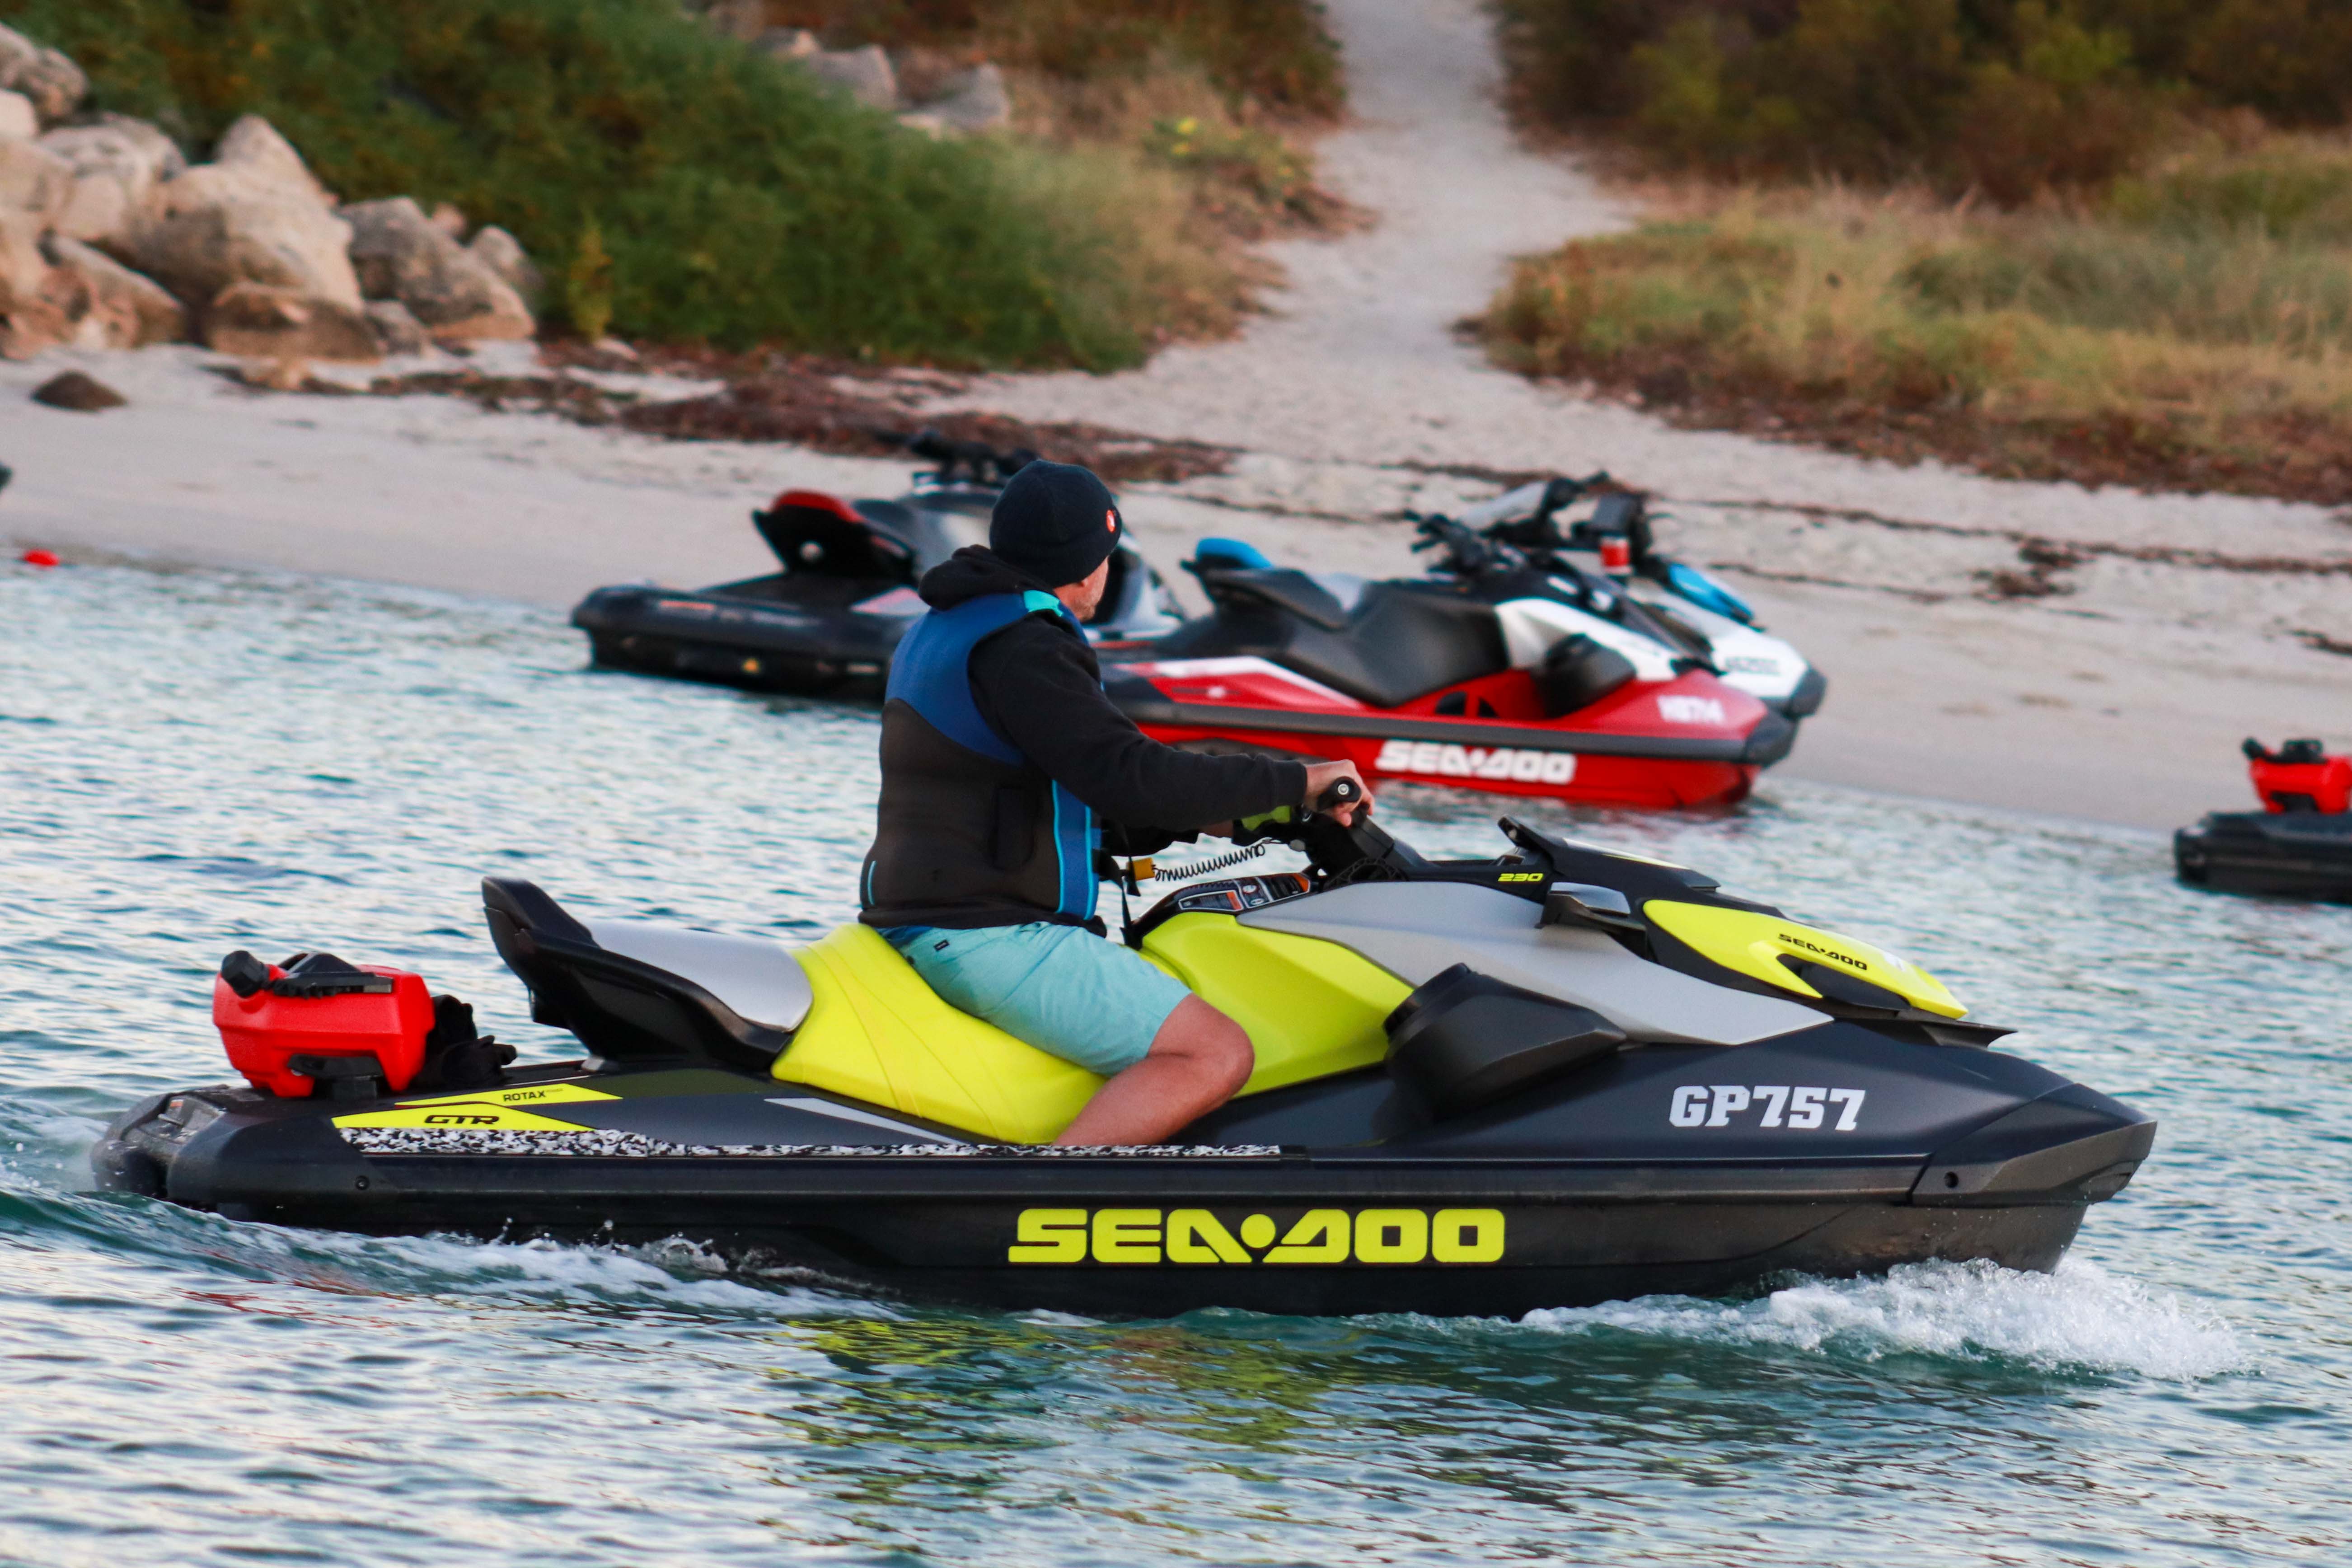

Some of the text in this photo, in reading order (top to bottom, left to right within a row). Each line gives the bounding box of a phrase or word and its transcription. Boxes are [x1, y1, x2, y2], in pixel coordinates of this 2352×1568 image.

[1498, 872, 1544, 882] 230
[503, 1091, 546, 1101] ROTAX
[1669, 1085, 1866, 1131] GP757
[424, 1114, 500, 1125] GTR
